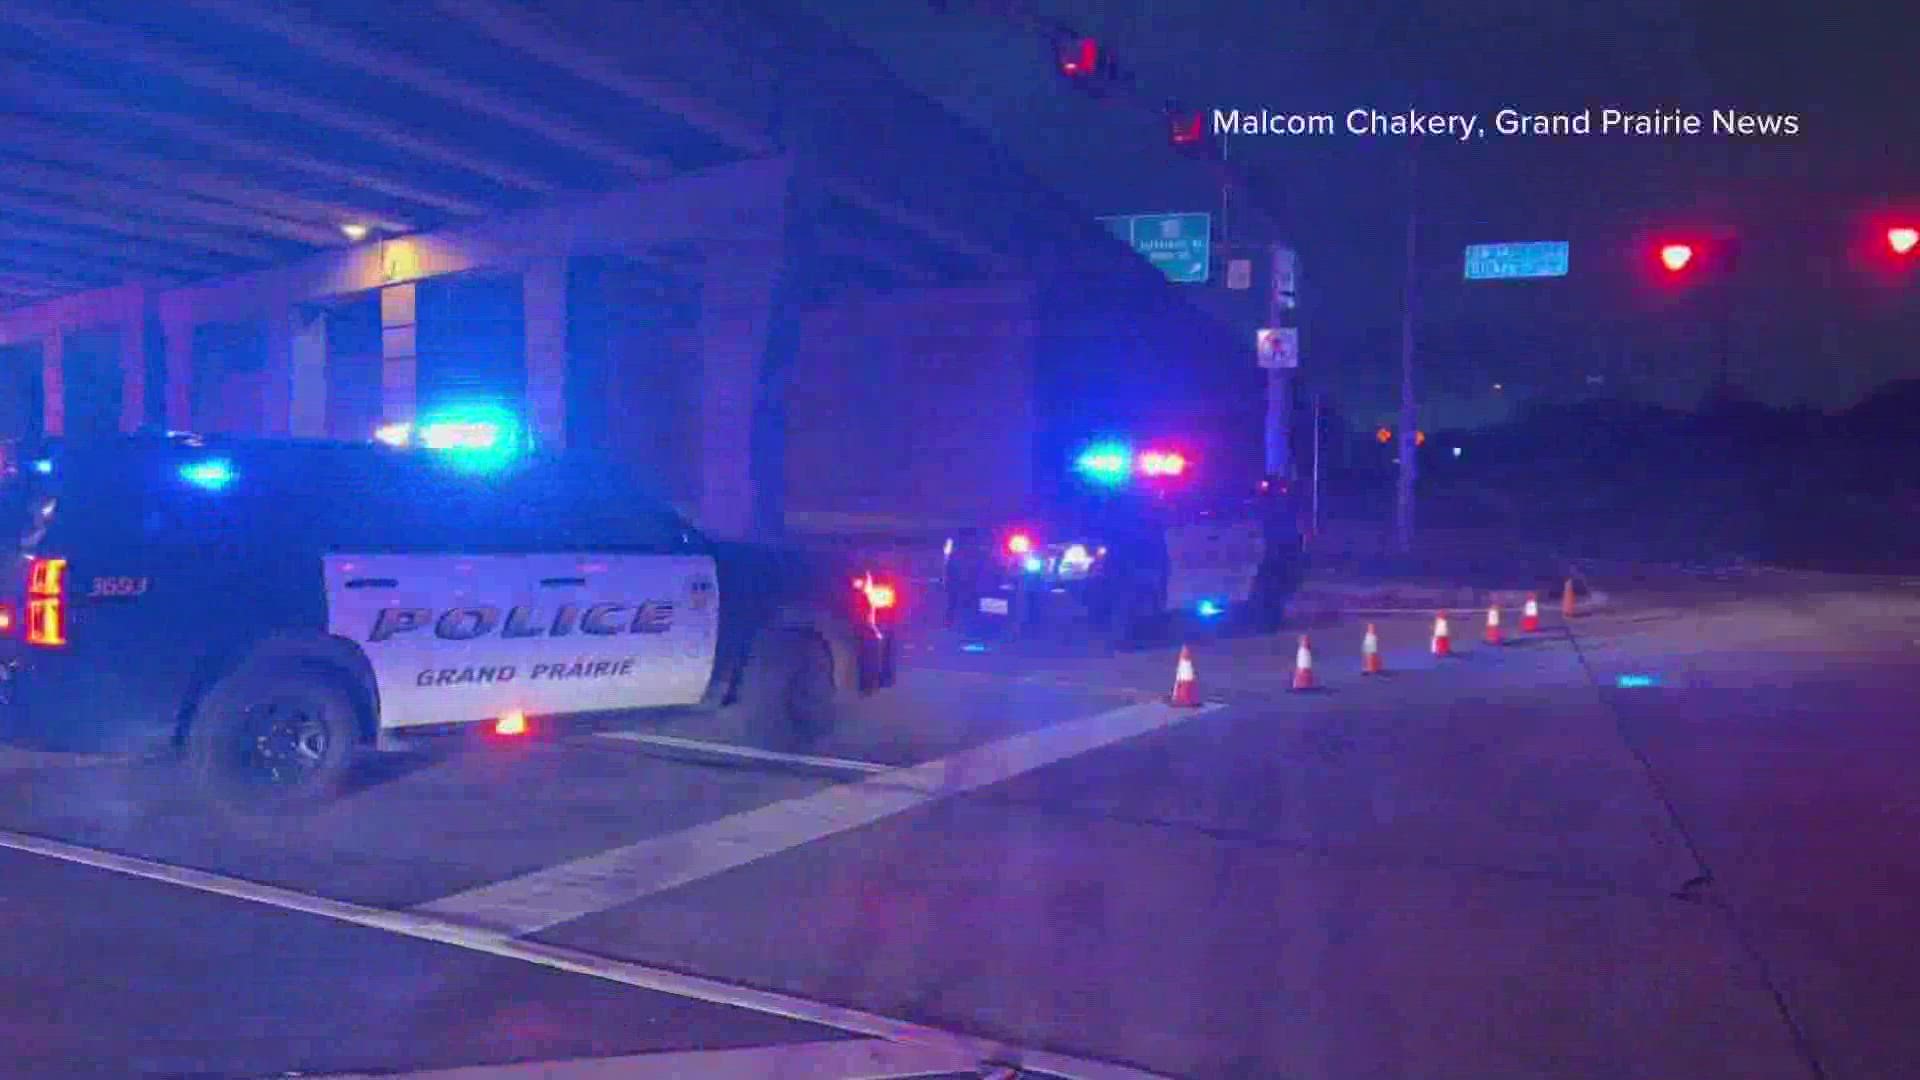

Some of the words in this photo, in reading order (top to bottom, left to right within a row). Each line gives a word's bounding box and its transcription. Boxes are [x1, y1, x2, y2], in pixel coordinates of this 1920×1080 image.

[367, 599, 674, 642] POLICE
[415, 665, 516, 687] GRAND
[530, 656, 635, 680] PRAIRIE
